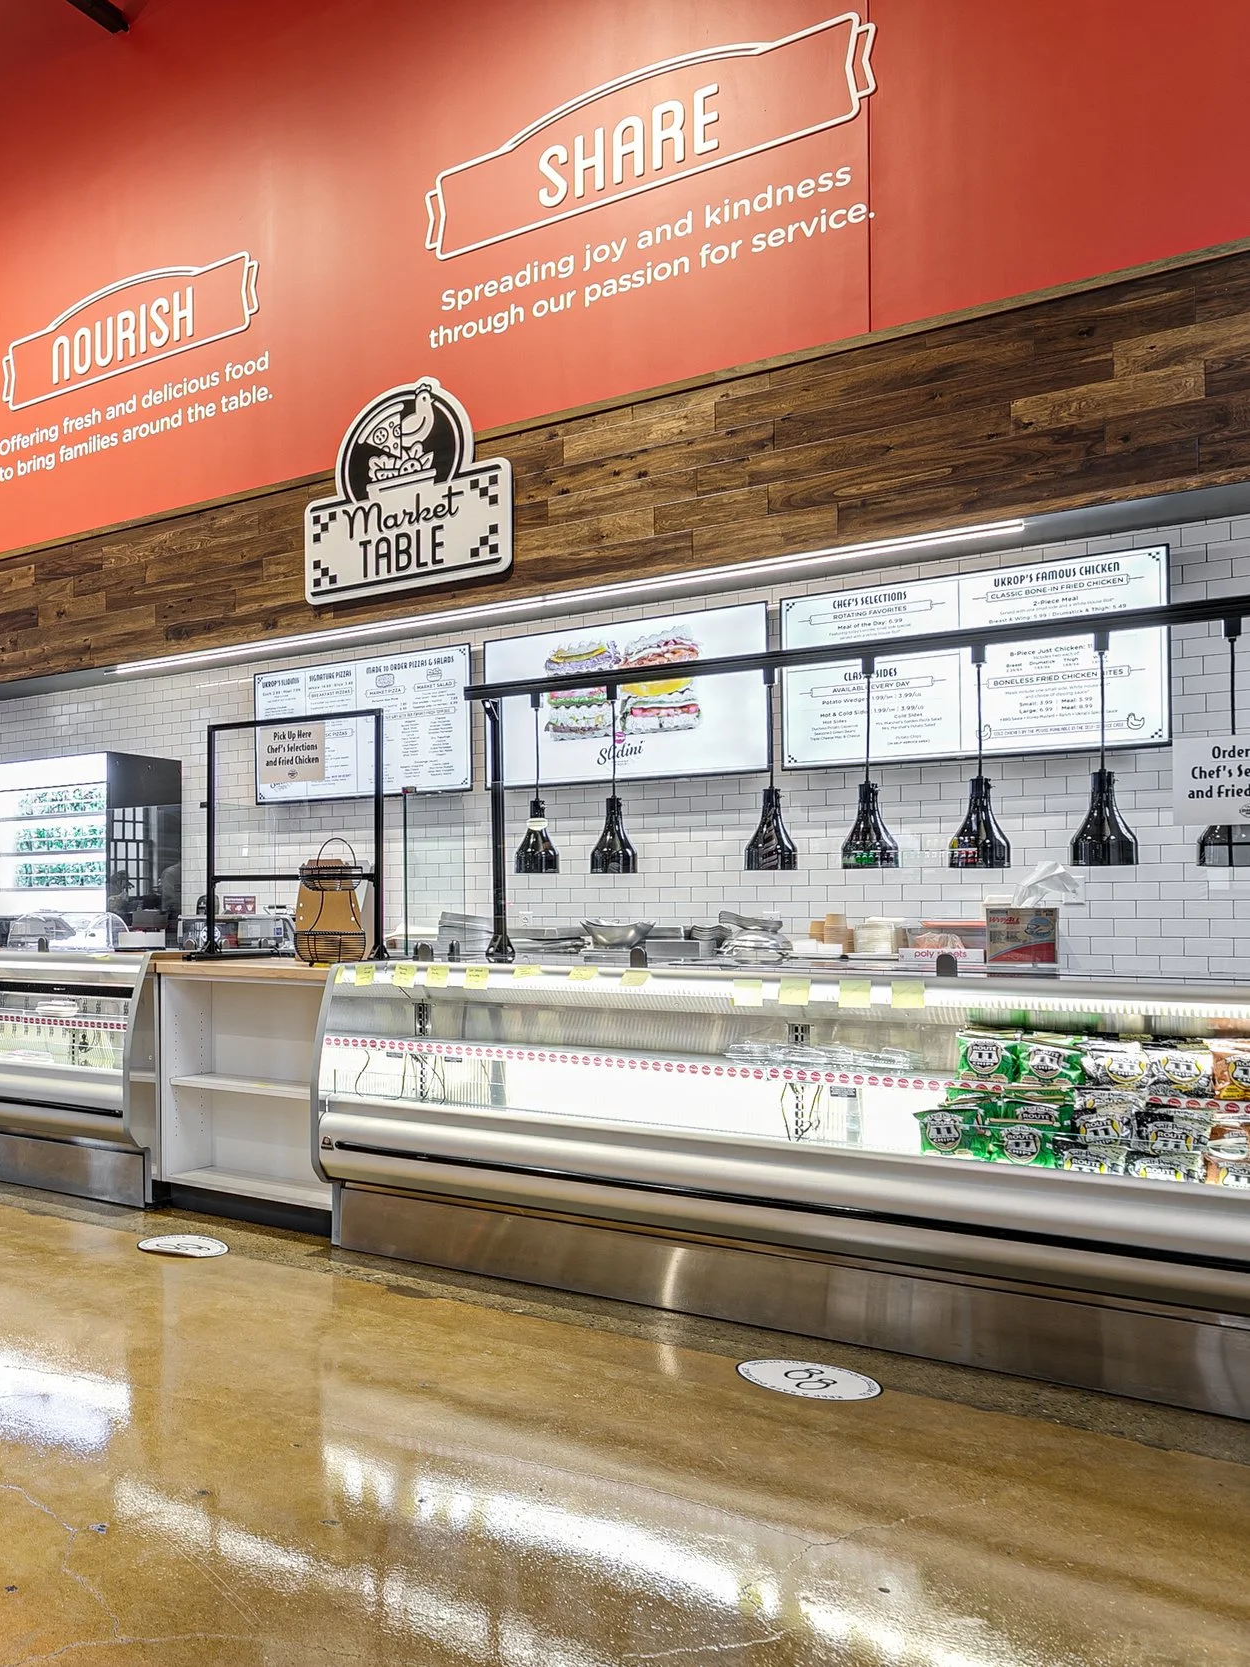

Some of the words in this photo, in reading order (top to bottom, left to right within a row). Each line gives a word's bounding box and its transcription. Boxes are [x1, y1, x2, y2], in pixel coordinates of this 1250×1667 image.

[538, 82, 720, 208] SHARE
[441, 252, 575, 312] Spreading
[583, 236, 628, 272] joy
[636, 211, 693, 251] and
[704, 165, 852, 229] kindness
[428, 304, 525, 349] through
[531, 288, 575, 318] our
[583, 254, 690, 308] passion
[699, 237, 743, 269] for
[750, 202, 876, 253] service.
[52, 285, 194, 385] NOURISH
[62, 408, 102, 435] fresh
[105, 394, 137, 420] and
[141, 372, 220, 409] delicious
[224, 350, 270, 382] food
[17, 451, 55, 478] bring
[59, 430, 119, 462] families
[122, 408, 182, 443] around
[186, 397, 216, 423] the
[220, 384, 273, 413] table.
[342, 486, 464, 539] Market
[359, 524, 444, 578] TABLE
[994, 573, 1033, 588] UKROP'S
[1036, 567, 1076, 582] FAMOUS
[1080, 561, 1120, 576] CHICKEN
[991, 591, 1023, 600] CLASSIC
[1025, 585, 1059, 596] BONE-IN
[1060, 582, 1084, 591] FRIED
[1086, 577, 1124, 588] CHICKEN
[833, 598, 858, 609] CHEF'S
[861, 591, 907, 605] SELECTIONS
[1033, 599, 1059, 607] 2-Piece
[833, 610, 867, 620] ROTATING
[869, 605, 907, 615] FAVORITES
[1052, 609, 1083, 617] Drumstick
[366, 665, 382, 674] MADE
[390, 662, 408, 671] ORDER
[409, 659, 427, 669] PIZZAS
[434, 656, 454, 665] SALADS
[844, 670, 872, 681] CLAS
[876, 668, 897, 678] SIDES
[993, 677, 1034, 686] BONELESS
[1035, 674, 1060, 682] FRIED
[1061, 671, 1098, 680] CHICKEN
[832, 685, 867, 693] AVAILABL
[871, 682, 894, 690] EVERY
[273, 730, 286, 741] Pick
[287, 730, 296, 741] Up
[297, 729, 312, 739] Here
[267, 744, 286, 754] Chef's
[287, 742, 318, 753] Selections
[597, 740, 644, 766] Sldini
[1212, 745, 1250, 759] Order
[265, 757, 278, 767] and
[278, 756, 294, 766] Fried
[295, 755, 320, 765] Chicken
[1191, 765, 1233, 780] Chef's
[1188, 785, 1213, 799] and
[1217, 784, 1250, 798] Fried
[914, 950, 934, 959] poly
[1085, 1119, 1112, 1128] ROUTE
[1157, 1131, 1186, 1139] ROUTE
[1072, 1158, 1101, 1168] ROUTE
[1146, 1168, 1176, 1176] ROUTE
